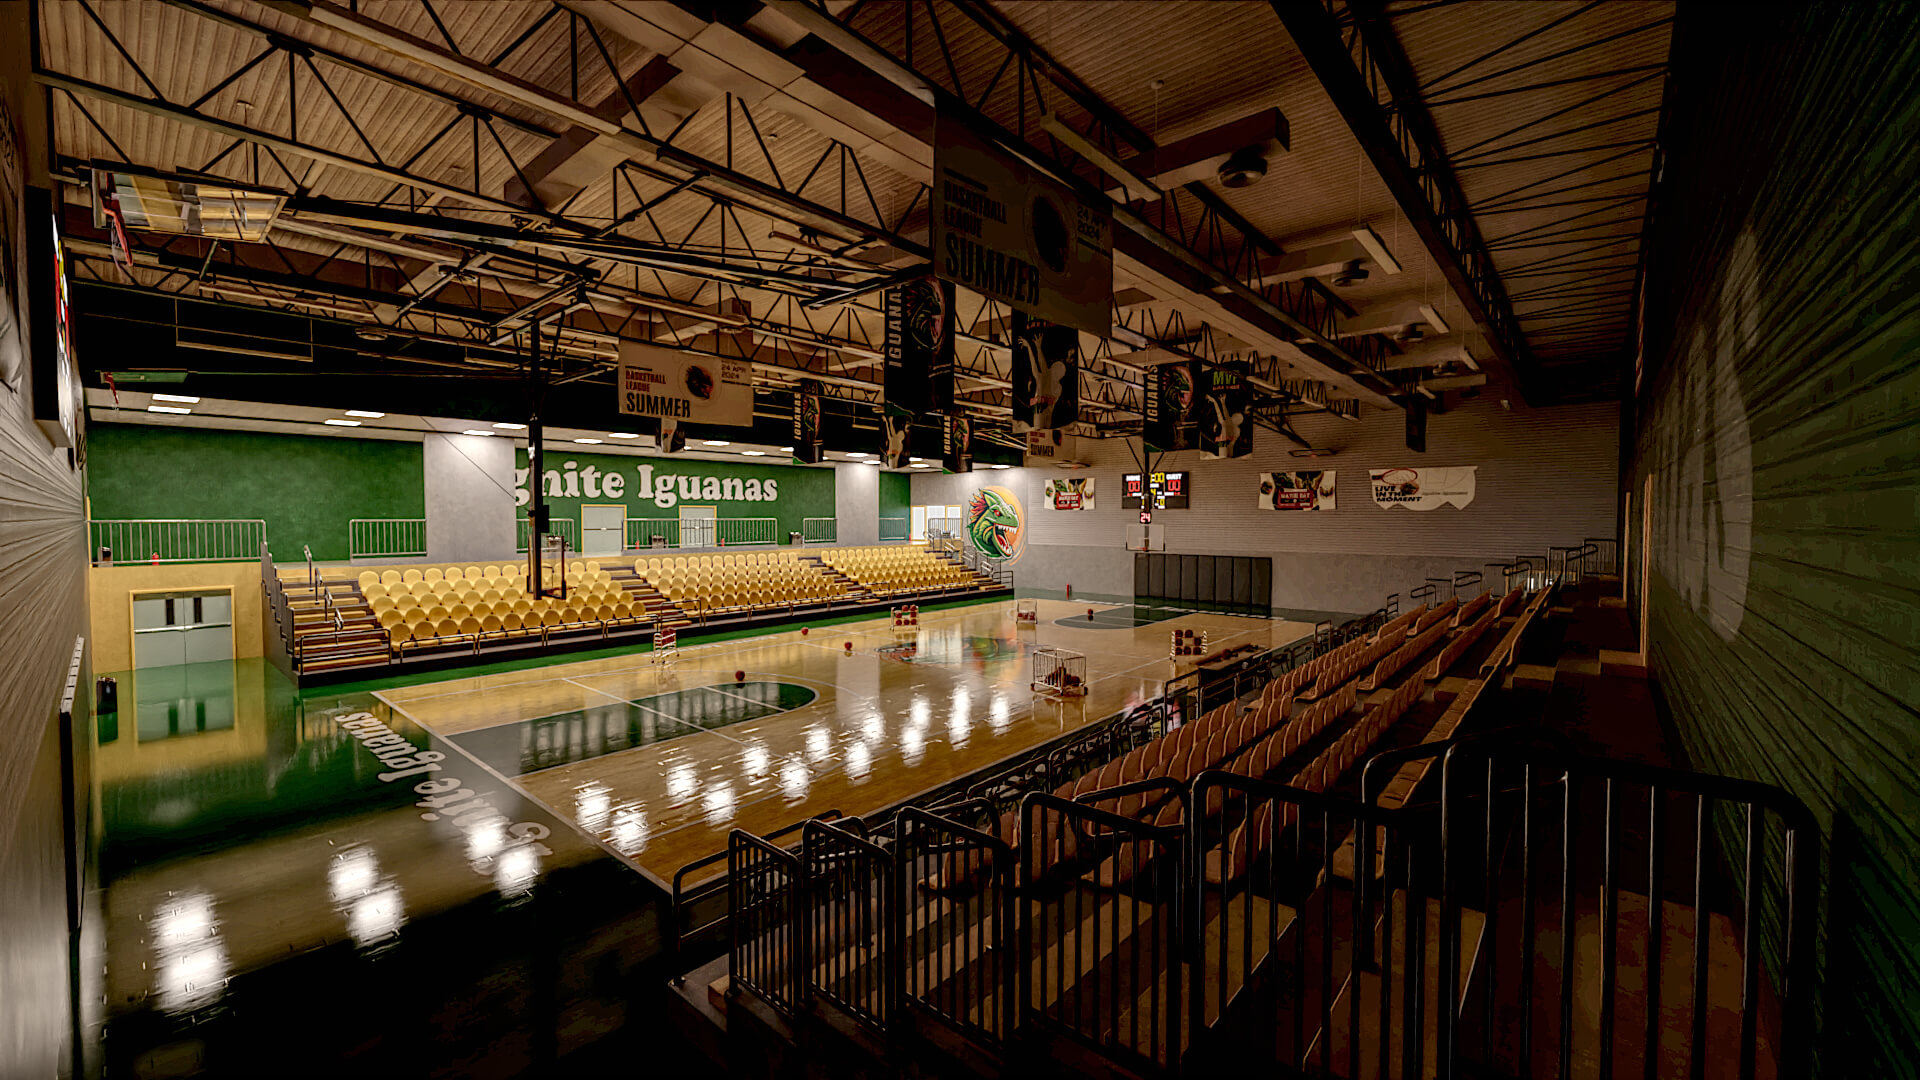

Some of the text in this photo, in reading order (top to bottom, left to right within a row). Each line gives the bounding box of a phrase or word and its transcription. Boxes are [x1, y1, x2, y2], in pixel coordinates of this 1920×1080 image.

[944, 180, 1008, 225] BASKETBALL
[944, 205, 983, 238] LEAGUE
[1077, 220, 1100, 241] 2024
[945, 232, 1040, 306] SUMMER
[887, 284, 904, 369] IGUANA
[625, 370, 667, 385] BASKETBALL
[625, 381, 651, 393] LEAGUE
[1146, 364, 1160, 424] IGUANAS
[626, 392, 691, 418] SUMMER
[793, 391, 802, 441] IGUANAS
[637, 463, 779, 509] Iguanas
[1140, 512, 1151, 523] 24
[334, 711, 447, 783] Iguanas
